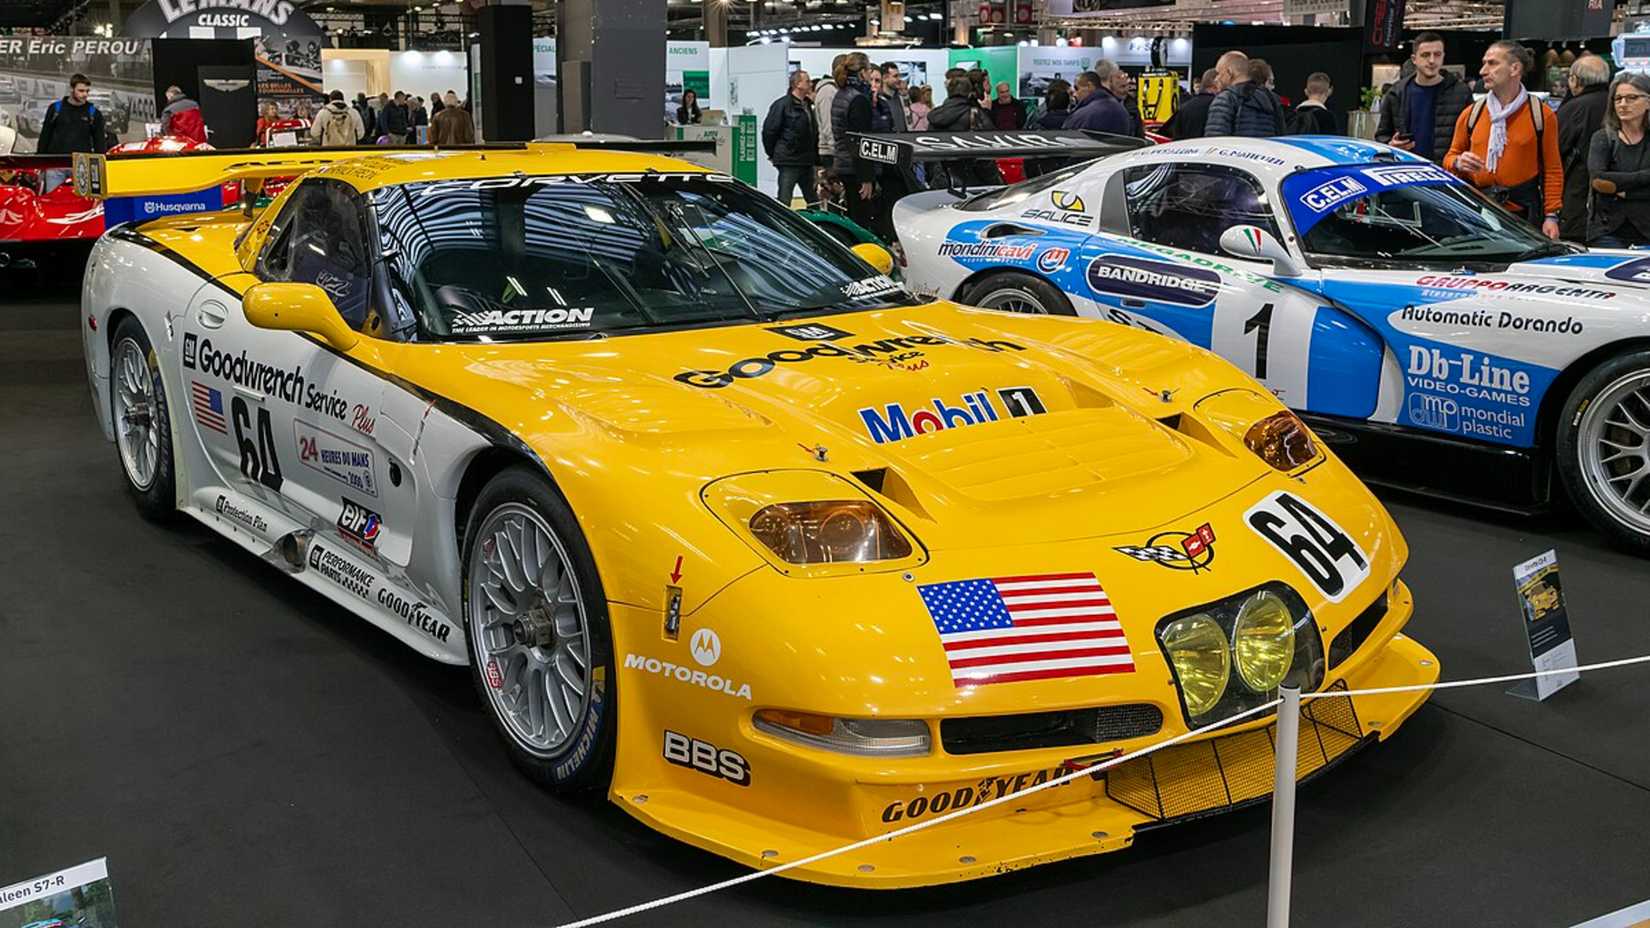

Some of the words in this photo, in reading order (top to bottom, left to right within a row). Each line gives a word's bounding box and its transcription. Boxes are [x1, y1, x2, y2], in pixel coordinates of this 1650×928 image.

[198, 14, 250, 27] CLASSIC
[28, 39, 66, 54] Eric
[69, 40, 139, 55] PEROU
[862, 140, 897, 162] C.EL.M
[1360, 165, 1453, 187] PIRELLI
[155, 202, 206, 213] Husqvarna
[1021, 209, 1094, 227] SALICE
[938, 241, 1038, 260] mondinicavi
[1098, 266, 1207, 293] BANDRIDGE
[483, 308, 594, 325] ACTION
[1402, 304, 1492, 328] Automatic
[1498, 312, 1583, 334] Dorando
[1244, 303, 1275, 380] 1
[674, 333, 1028, 389] Goodwrech
[1408, 345, 1530, 394] Db-Line
[200, 338, 304, 405] Goodwrench
[305, 382, 347, 420] Service
[352, 404, 376, 435] Plus
[1408, 376, 1531, 407] VIDEO-GAMES
[858, 391, 998, 444] Mobil
[1462, 405, 1525, 427] mondial
[1462, 420, 1512, 439] plastic
[231, 396, 283, 493] 64
[300, 436, 318, 462] 24
[351, 451, 369, 468] MANS
[342, 503, 367, 532] elf
[1248, 493, 1368, 597] 64
[320, 563, 341, 584] PARTS
[322, 551, 375, 588] PERFORMANCE
[377, 587, 451, 643] GOODYEAR
[624, 653, 752, 701] MOTOROLA
[557, 707, 600, 781] MICHELIN
[663, 730, 751, 785] BBS
[882, 766, 1074, 823] GOODYEAR
[0, 887, 31, 904] leen
[34, 875, 65, 893] S7-R
